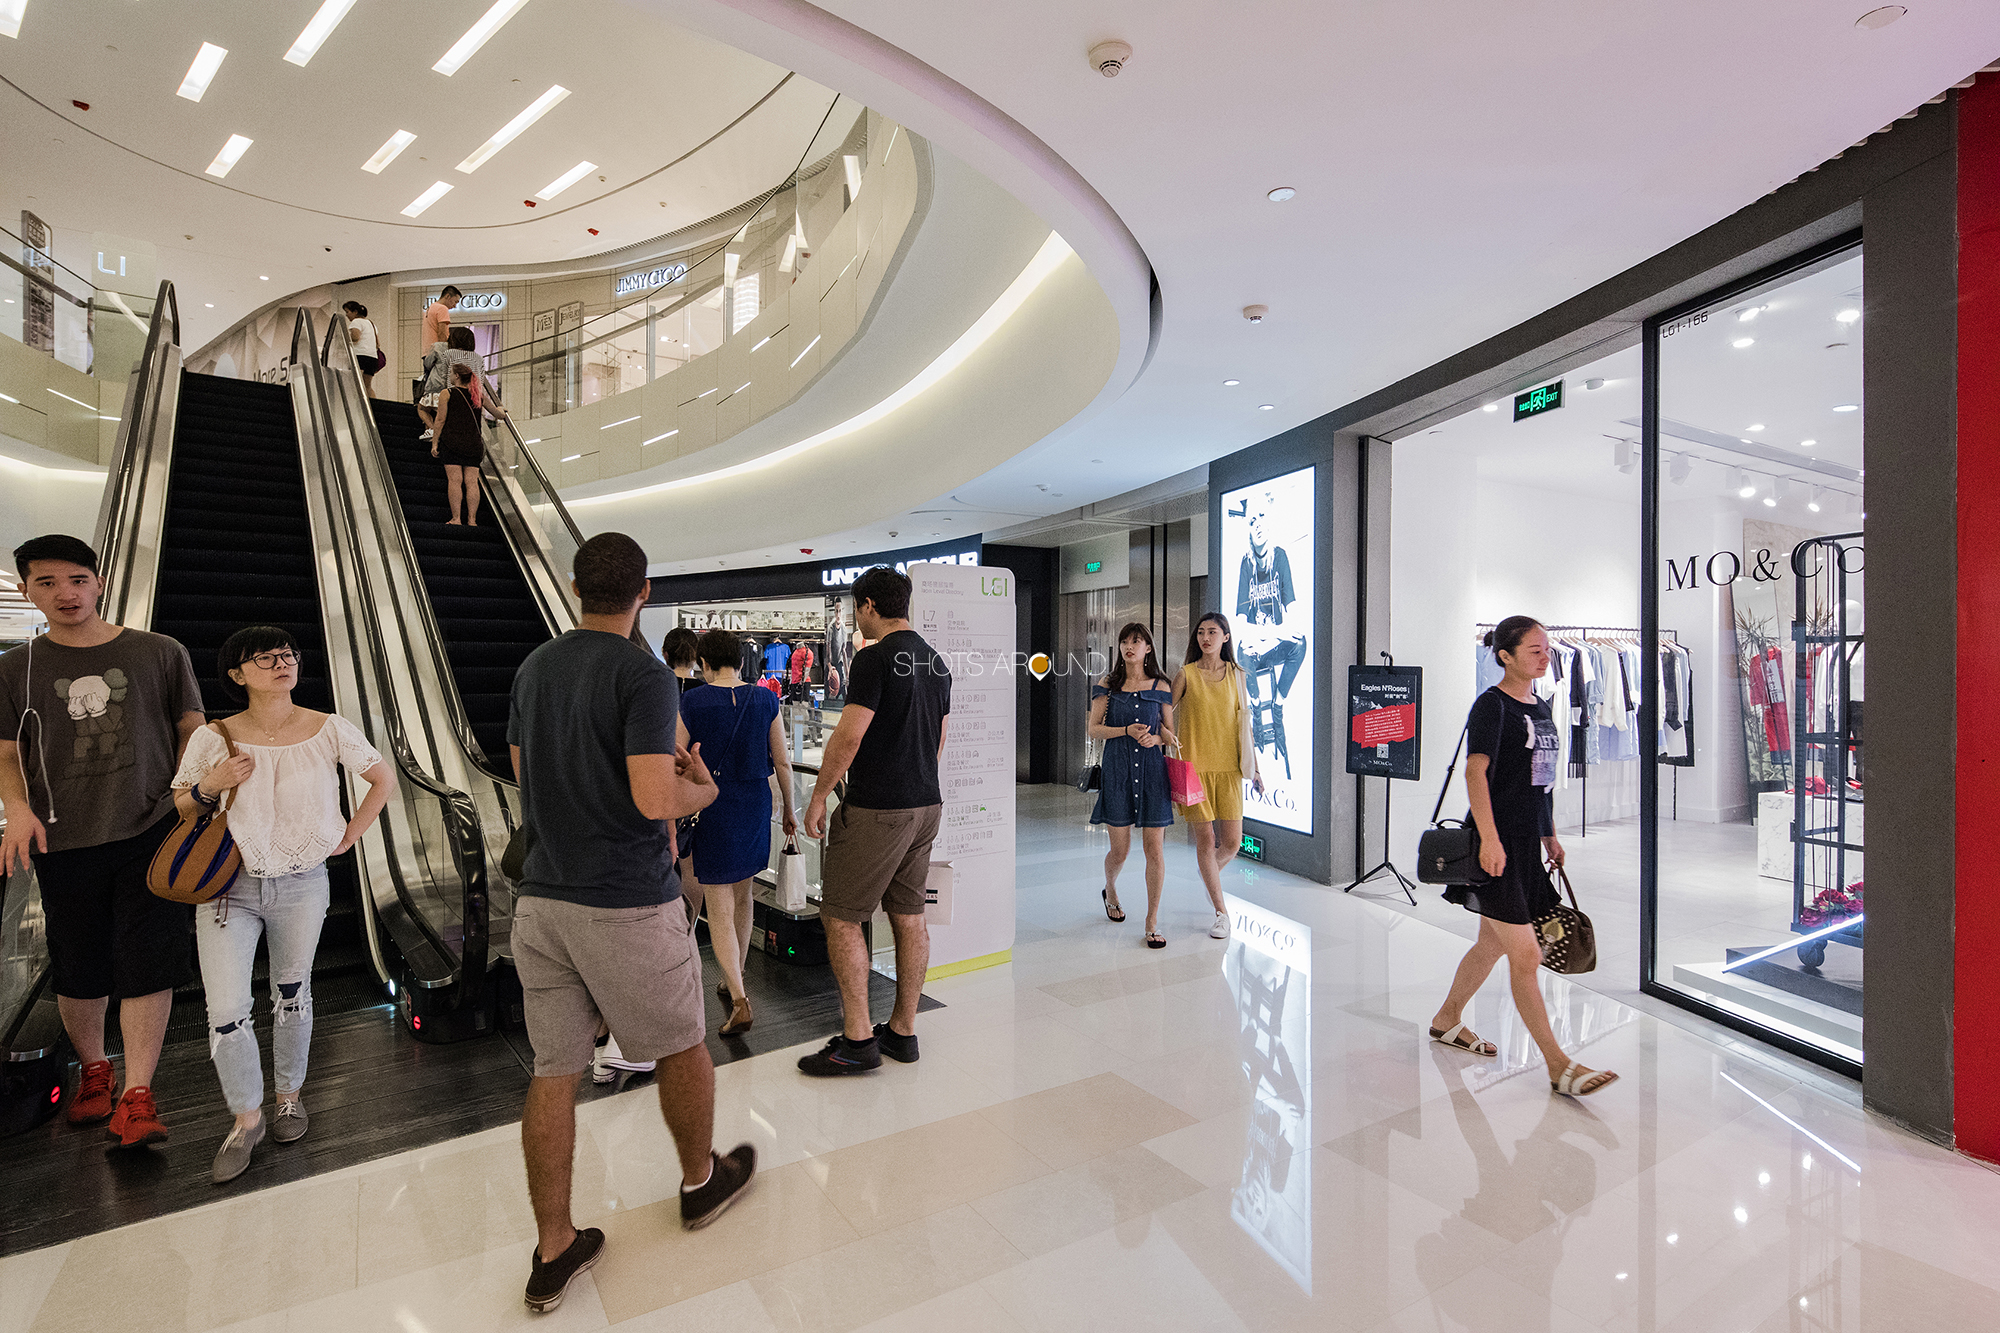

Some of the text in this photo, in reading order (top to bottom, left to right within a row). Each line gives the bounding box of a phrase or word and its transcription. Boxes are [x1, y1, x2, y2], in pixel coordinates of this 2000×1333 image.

[616, 264, 685, 292] JIMMY CHOO
[461, 293, 502, 309] CHOO
[1546, 391, 1559, 403] EXIT
[681, 613, 747, 631] TRAIN
[1361, 683, 1381, 693] Eagles
[1382, 684, 1407, 692] N'Roses
